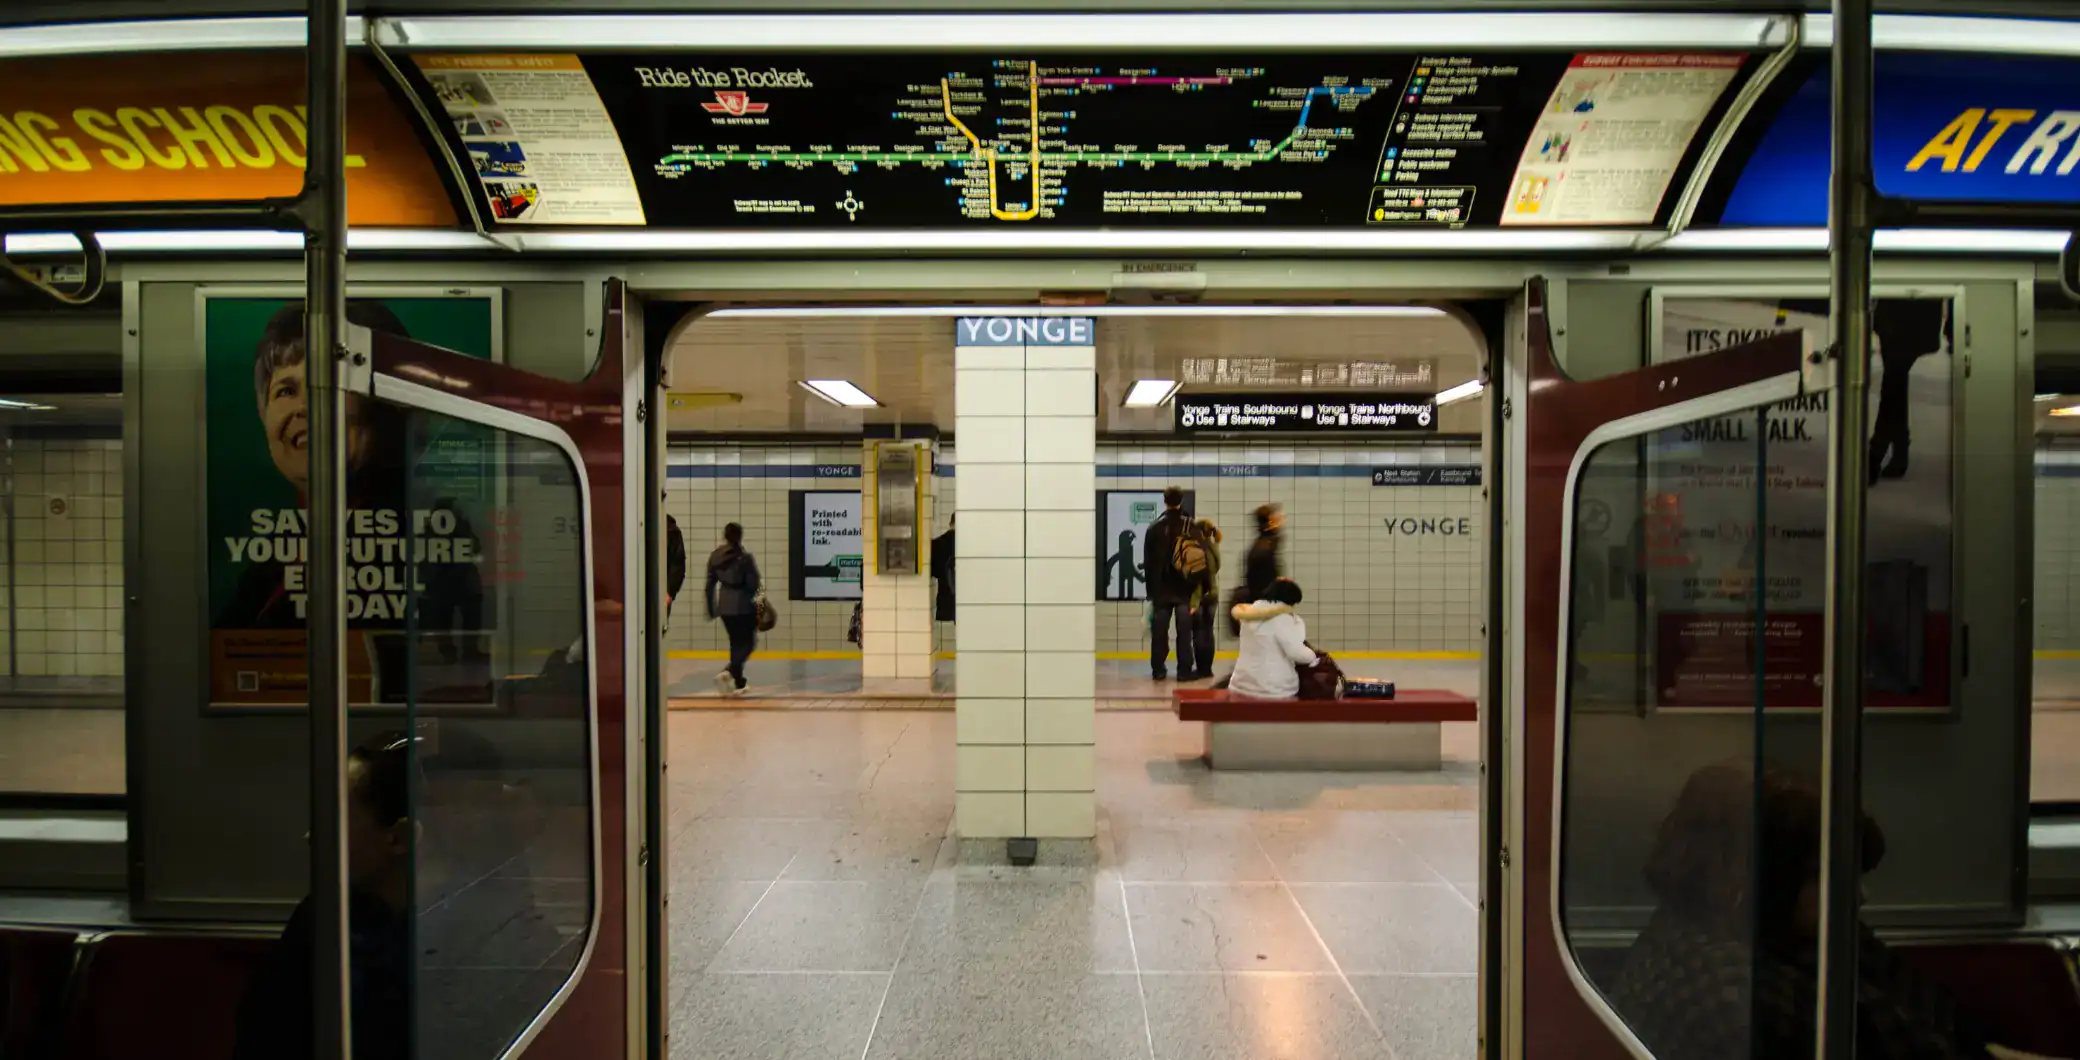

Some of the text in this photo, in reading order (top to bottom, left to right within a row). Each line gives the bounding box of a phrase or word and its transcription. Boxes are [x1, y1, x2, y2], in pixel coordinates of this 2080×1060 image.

[634, 67, 813, 88] Ride the Rocket.
[73, 105, 366, 171] SCHOO
[1904, 108, 2036, 172] AT
[964, 317, 1087, 342] YONGE
[1686, 329, 1720, 354] IT'S
[1182, 404, 1298, 416] Yonge Trains Southbound
[1318, 404, 1432, 416] Yonge Trains Northbound
[1196, 414, 1276, 426] Use Stairways
[1316, 414, 1397, 426] Use Stairways
[1682, 418, 1812, 441] SMALL ALK.
[818, 467, 854, 475] YONGE
[1221, 466, 1258, 475] YONGE
[812, 509, 847, 518] Printed
[347, 508, 400, 535] ES
[411, 508, 457, 535] TO
[812, 519, 832, 527] with
[1384, 518, 1470, 535] YONGE
[812, 528, 862, 536] re-readabl
[812, 537, 831, 545] ink.
[283, 564, 426, 592] EROLL
